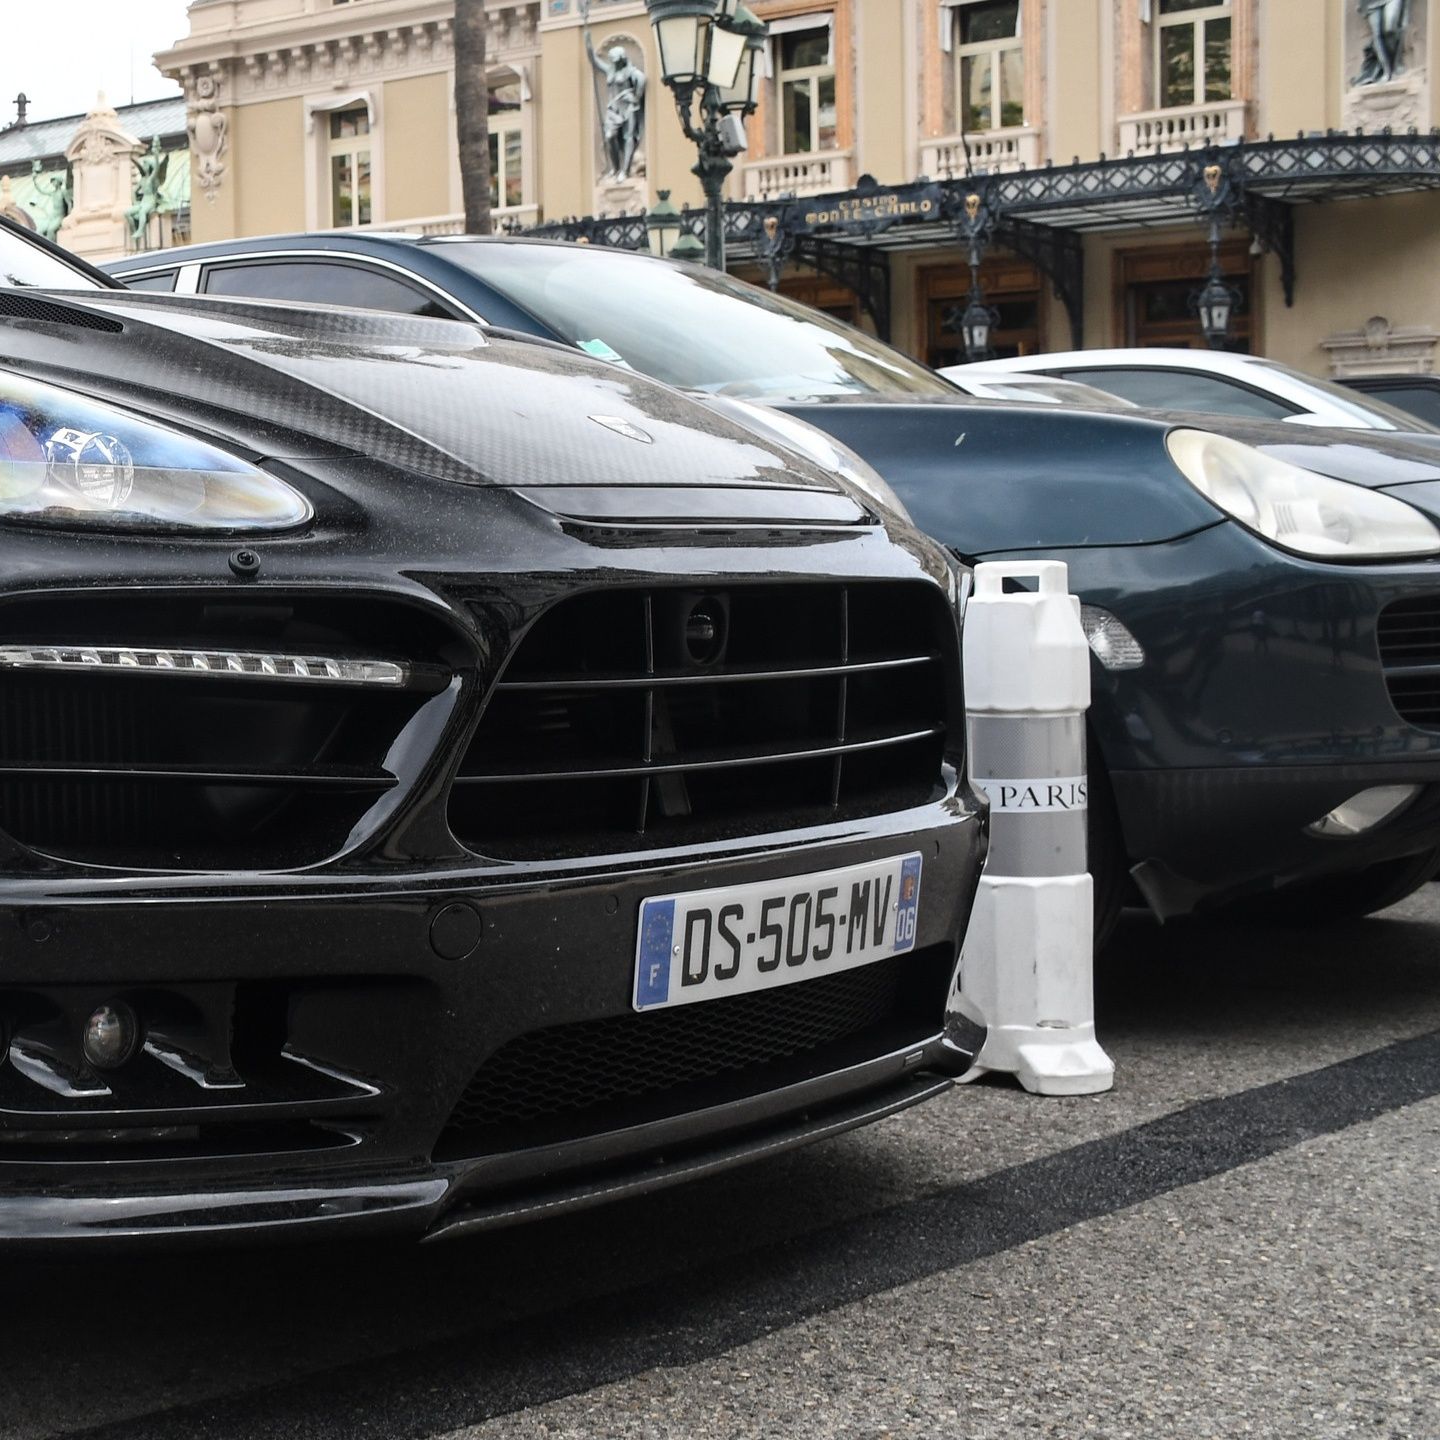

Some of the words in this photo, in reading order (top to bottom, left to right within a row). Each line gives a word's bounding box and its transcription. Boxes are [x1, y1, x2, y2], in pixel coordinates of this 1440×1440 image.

[839, 194, 898, 211] CASINO
[1000, 783, 1087, 809] PARIS
[681, 875, 893, 987] DS-505-MV
[896, 906, 915, 942] 06
[650, 963, 660, 987] F
